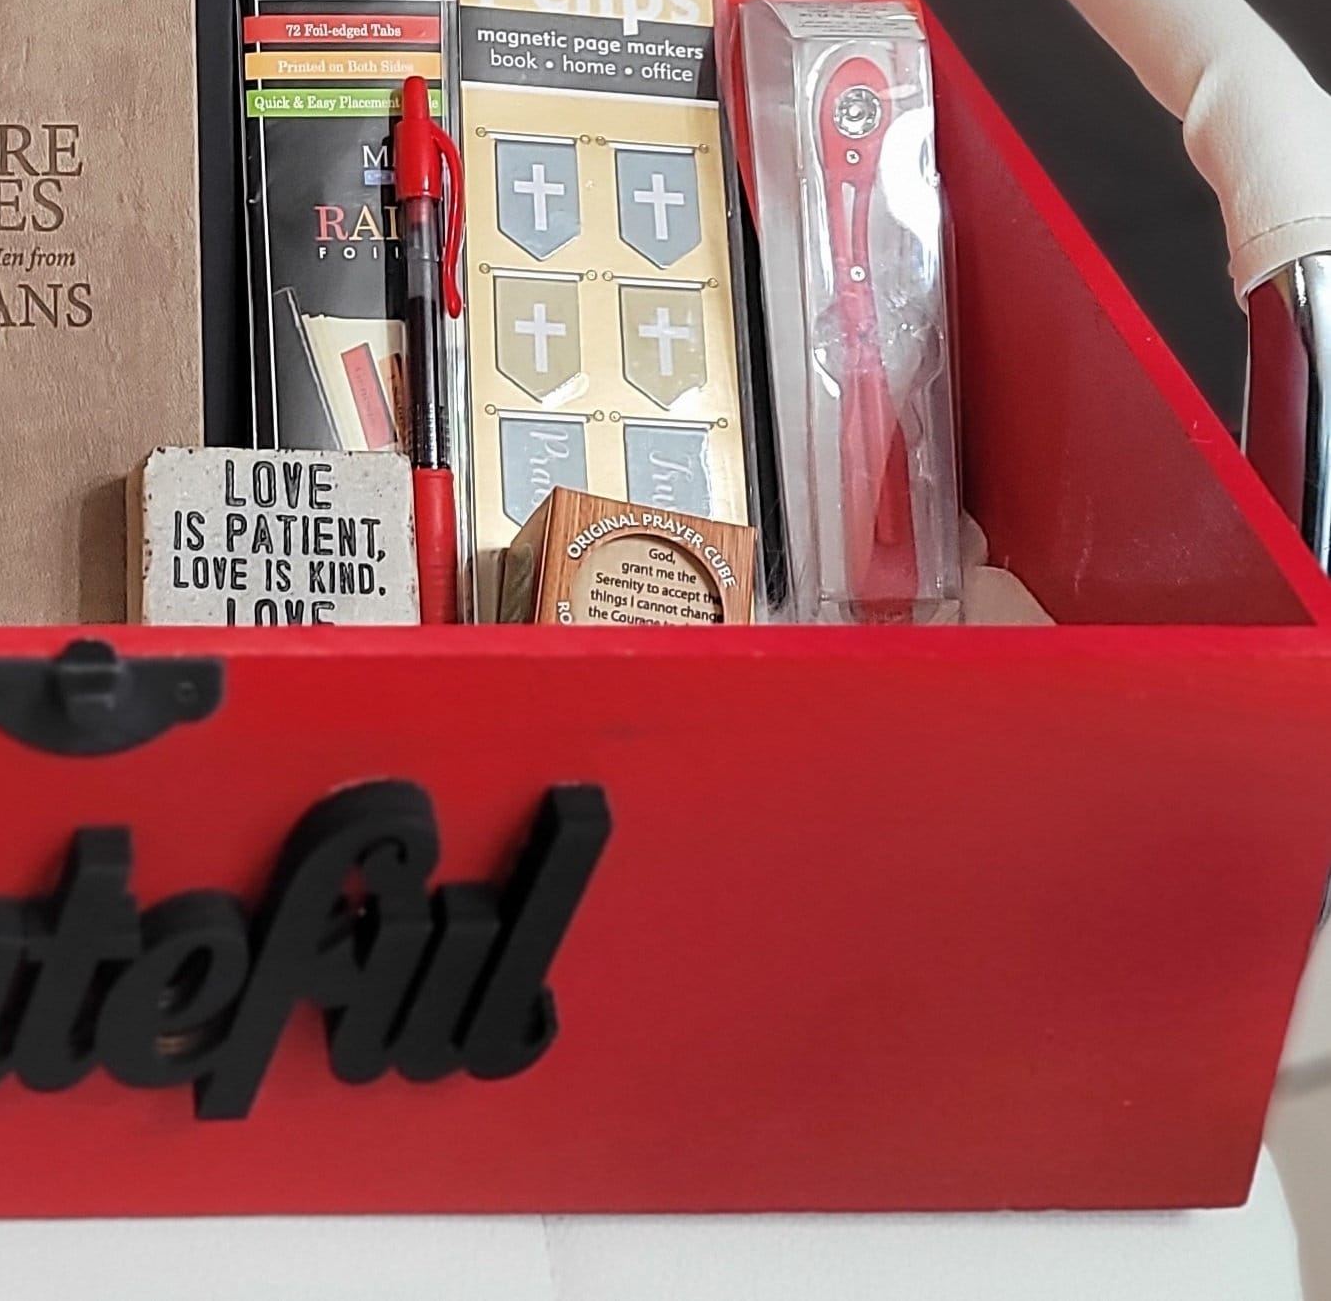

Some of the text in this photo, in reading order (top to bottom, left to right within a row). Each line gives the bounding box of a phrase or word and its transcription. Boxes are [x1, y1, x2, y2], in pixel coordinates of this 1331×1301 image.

[285, 24, 401, 39] 72 Foil-edged Tabs
[477, 28, 704, 59] magnetic page markers
[277, 60, 415, 75] Printed on Both Sides
[490, 49, 693, 82] book home office
[254, 96, 401, 112] Quick & Easy Placement
[313, 204, 400, 241] RAI
[26, 247, 76, 273] from
[225, 459, 332, 510] LOVE
[173, 510, 386, 563] IS PATIENT,
[567, 513, 738, 588] ORIGINAL PRAYER CUBE
[649, 548, 676, 565] God,
[173, 555, 386, 596] LOVE IS KIND.
[621, 561, 697, 584] grant me the
[590, 588, 627, 608] things
[637, 599, 677, 616] cannot
[596, 572, 644, 594] Serenity
[646, 582, 659, 595] to
[661, 586, 701, 603] accept
[588, 606, 608, 619] the
